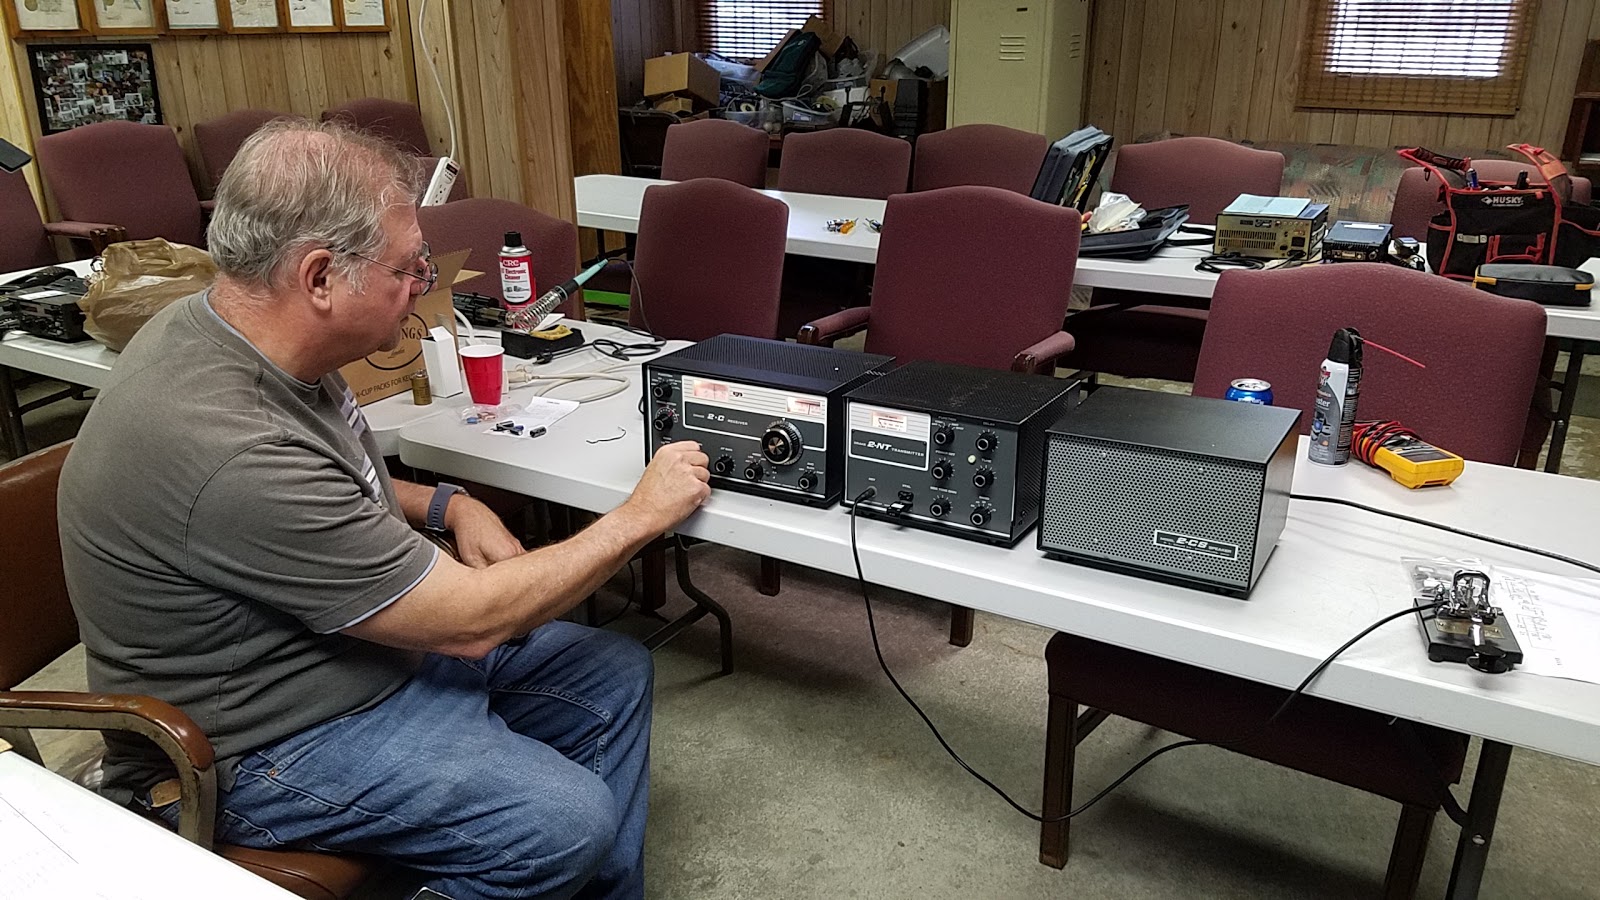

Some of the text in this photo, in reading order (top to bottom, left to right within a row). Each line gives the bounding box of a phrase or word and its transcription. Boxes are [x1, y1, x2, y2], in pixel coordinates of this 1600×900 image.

[1493, 196, 1523, 204] HUSKY
[401, 326, 423, 340] NGS
[355, 387, 373, 398] K-CUP
[373, 381, 390, 392] PACKS
[391, 377, 402, 387] FOR
[891, 447, 925, 457] TRANSMITTER
